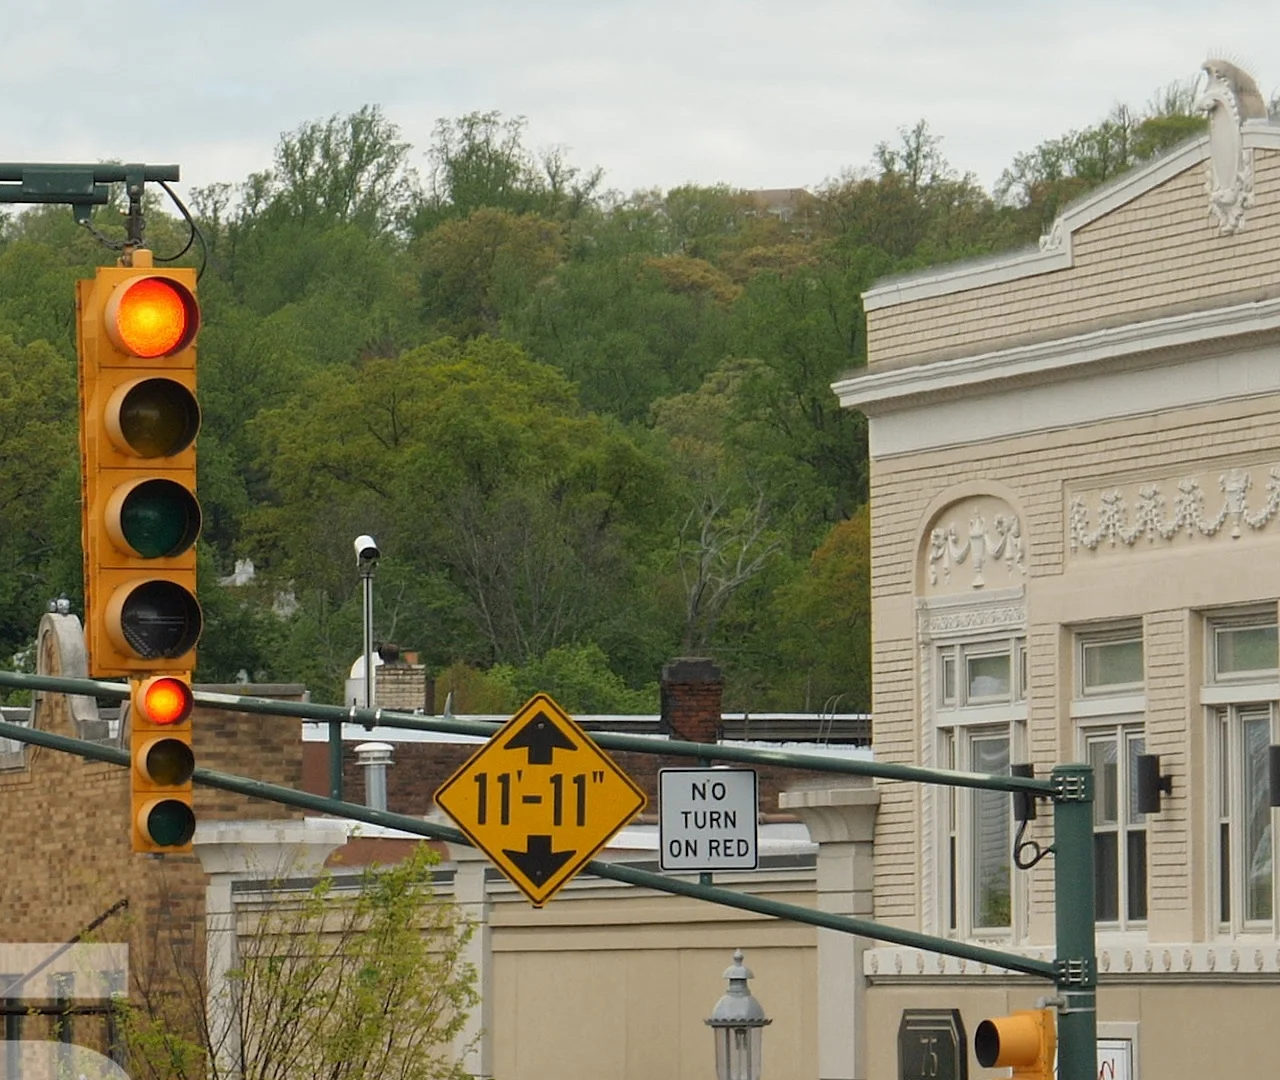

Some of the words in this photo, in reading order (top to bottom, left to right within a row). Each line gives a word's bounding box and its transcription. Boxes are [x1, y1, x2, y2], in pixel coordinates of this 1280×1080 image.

[691, 782, 726, 801] NO
[680, 810, 737, 829] TURN
[669, 839, 697, 858] ON
[709, 839, 750, 857] RED
[920, 1037, 938, 1077] 75
